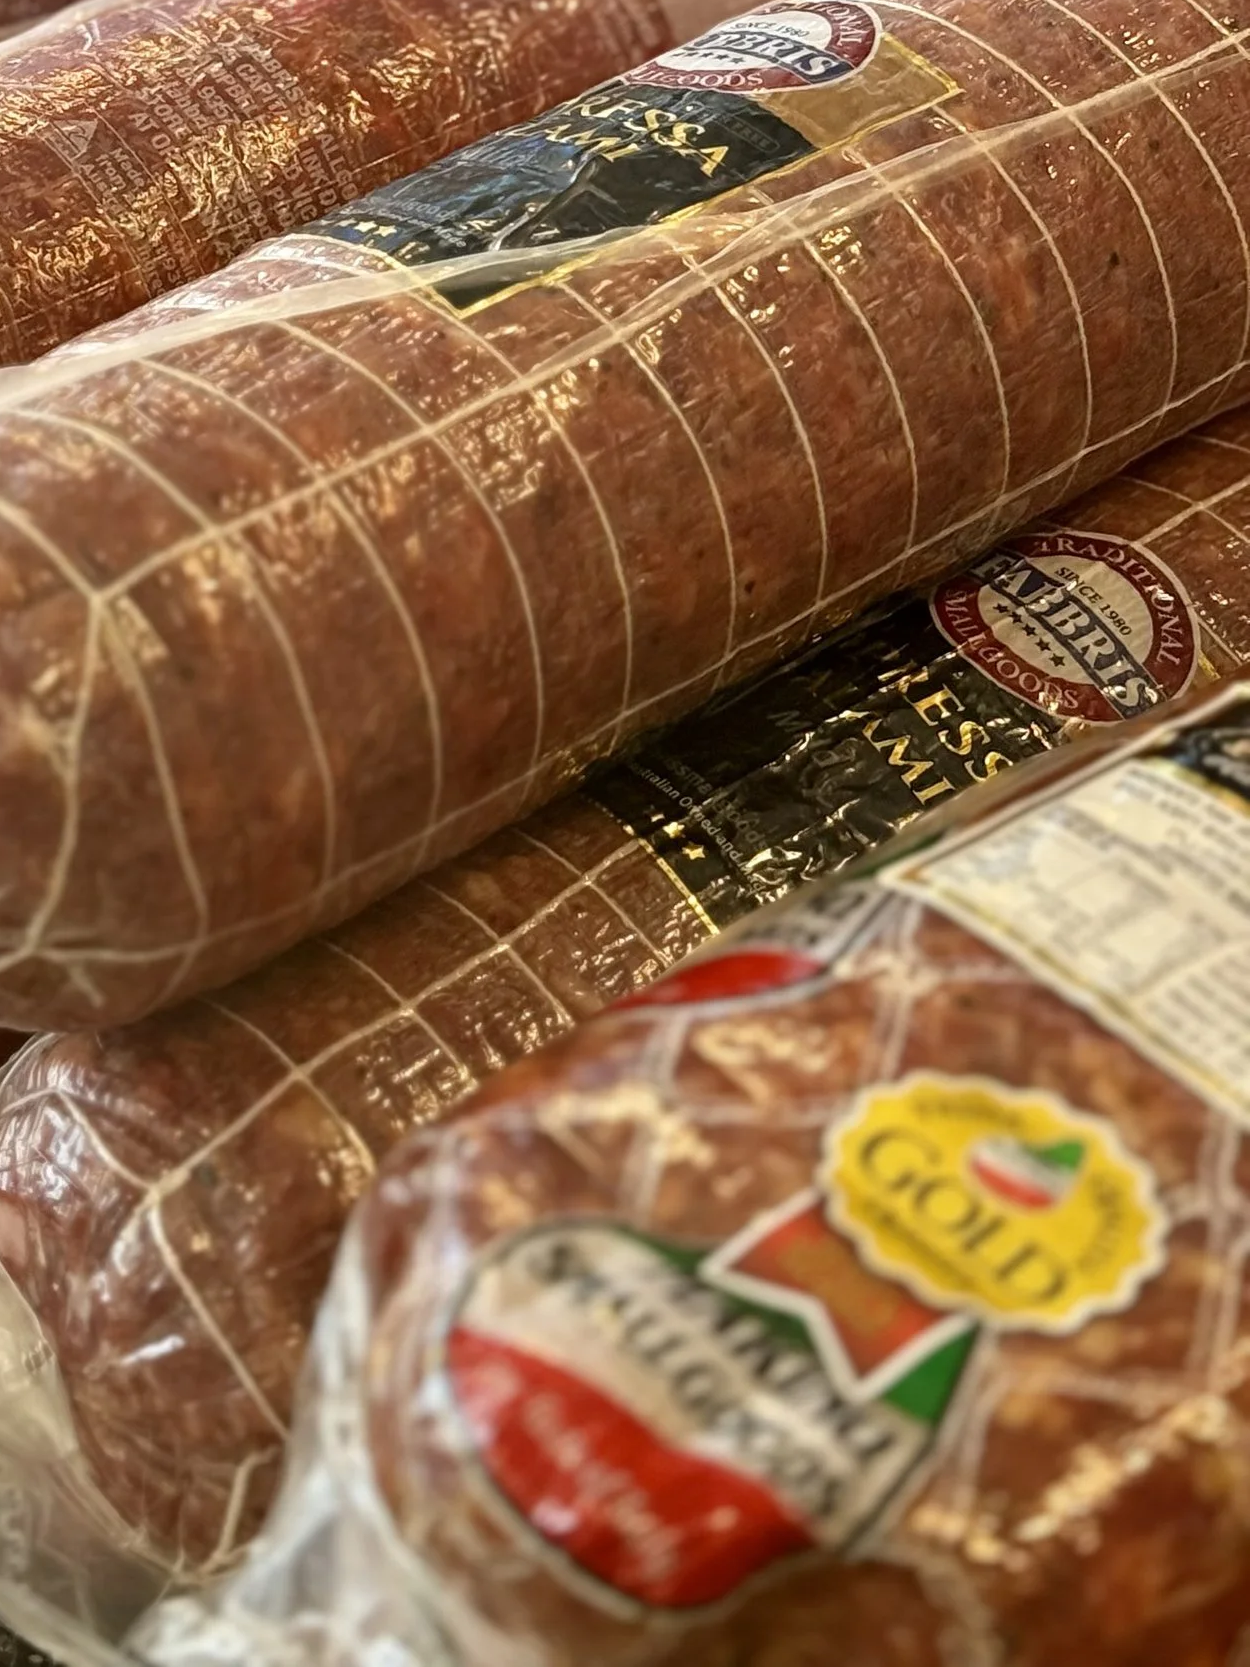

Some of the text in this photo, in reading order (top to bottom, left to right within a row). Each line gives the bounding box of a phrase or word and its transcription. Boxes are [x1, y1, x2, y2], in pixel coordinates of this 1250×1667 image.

[94, 152, 128, 191] from
[109, 145, 148, 190] Made
[969, 550, 1151, 708] FABBRIS
[1099, 602, 1133, 637] 1980
[714, 832, 742, 862] and
[859, 1128, 1068, 1302] GOLD
